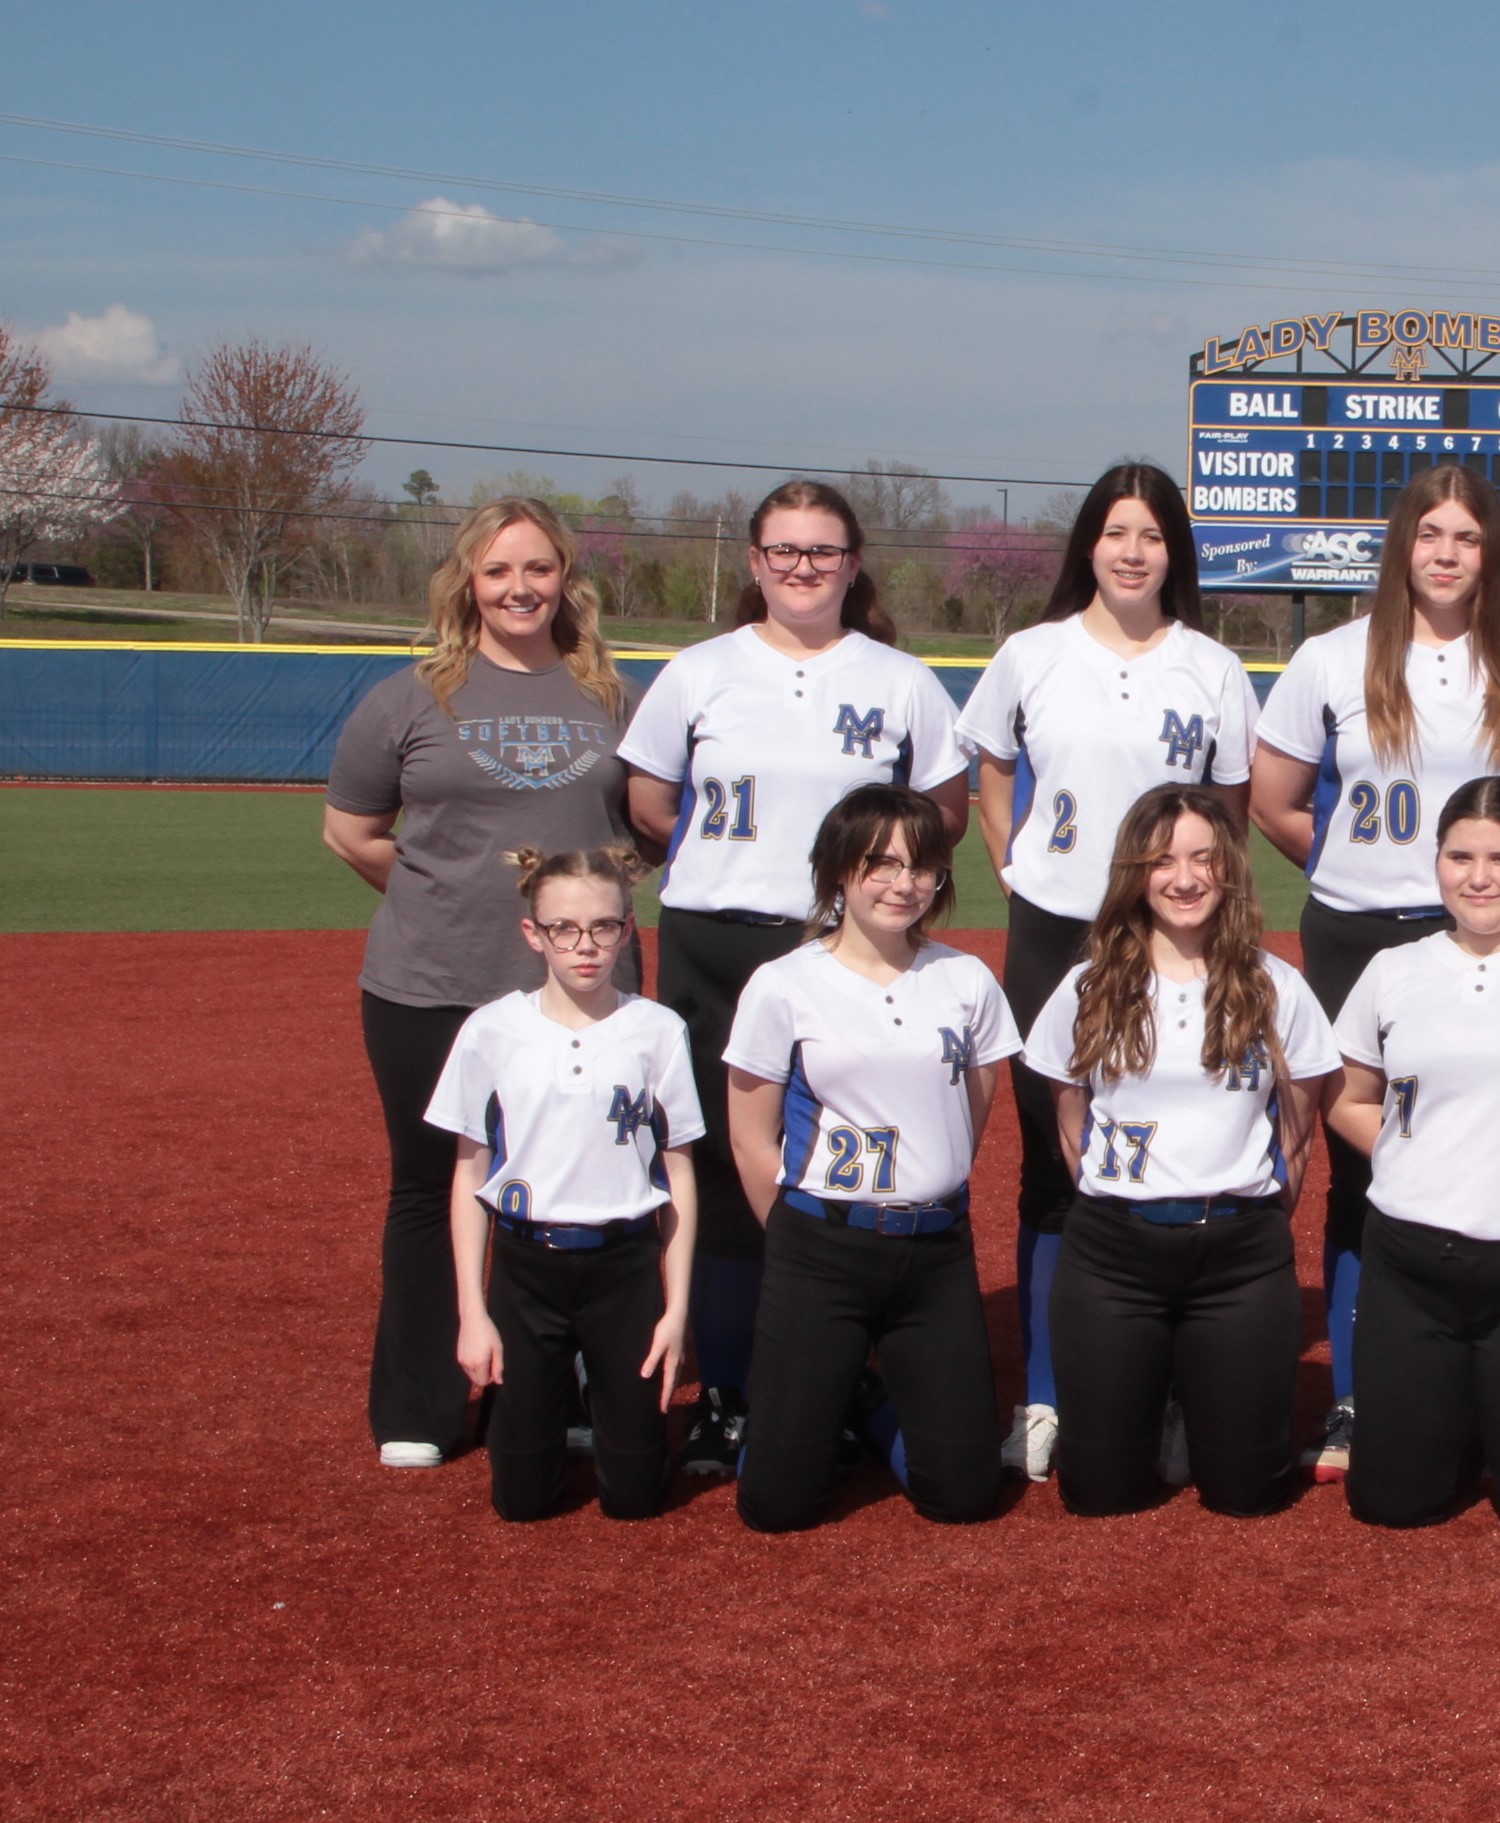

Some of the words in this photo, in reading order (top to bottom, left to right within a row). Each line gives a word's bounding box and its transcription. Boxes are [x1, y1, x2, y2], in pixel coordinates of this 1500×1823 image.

[1203, 311, 1344, 376] LADY
[1229, 392, 1299, 418] BALL
[1345, 394, 1441, 421] STRIKE
[1306, 434, 1315, 448] 1
[1333, 434, 1344, 449] 2
[1361, 435, 1371, 449] 3
[1388, 435, 1399, 450] 4
[1415, 436, 1426, 450] 5
[1443, 436, 1454, 450] 6
[1471, 437, 1482, 451] 7
[1198, 452, 1295, 477] VISITOR
[1194, 486, 1297, 512] BOMBERS
[1201, 534, 1271, 560] Sponsored
[1303, 531, 1373, 569] ASC
[1236, 559, 1258, 576] By:
[458, 724, 606, 745] SOFTBALL
[500, 716, 522, 724] LADY
[701, 776, 757, 842] 21
[1048, 789, 1077, 853] 2
[1349, 780, 1421, 845] 20
[825, 1126, 900, 1193] 27
[1097, 1120, 1158, 1183] 17
